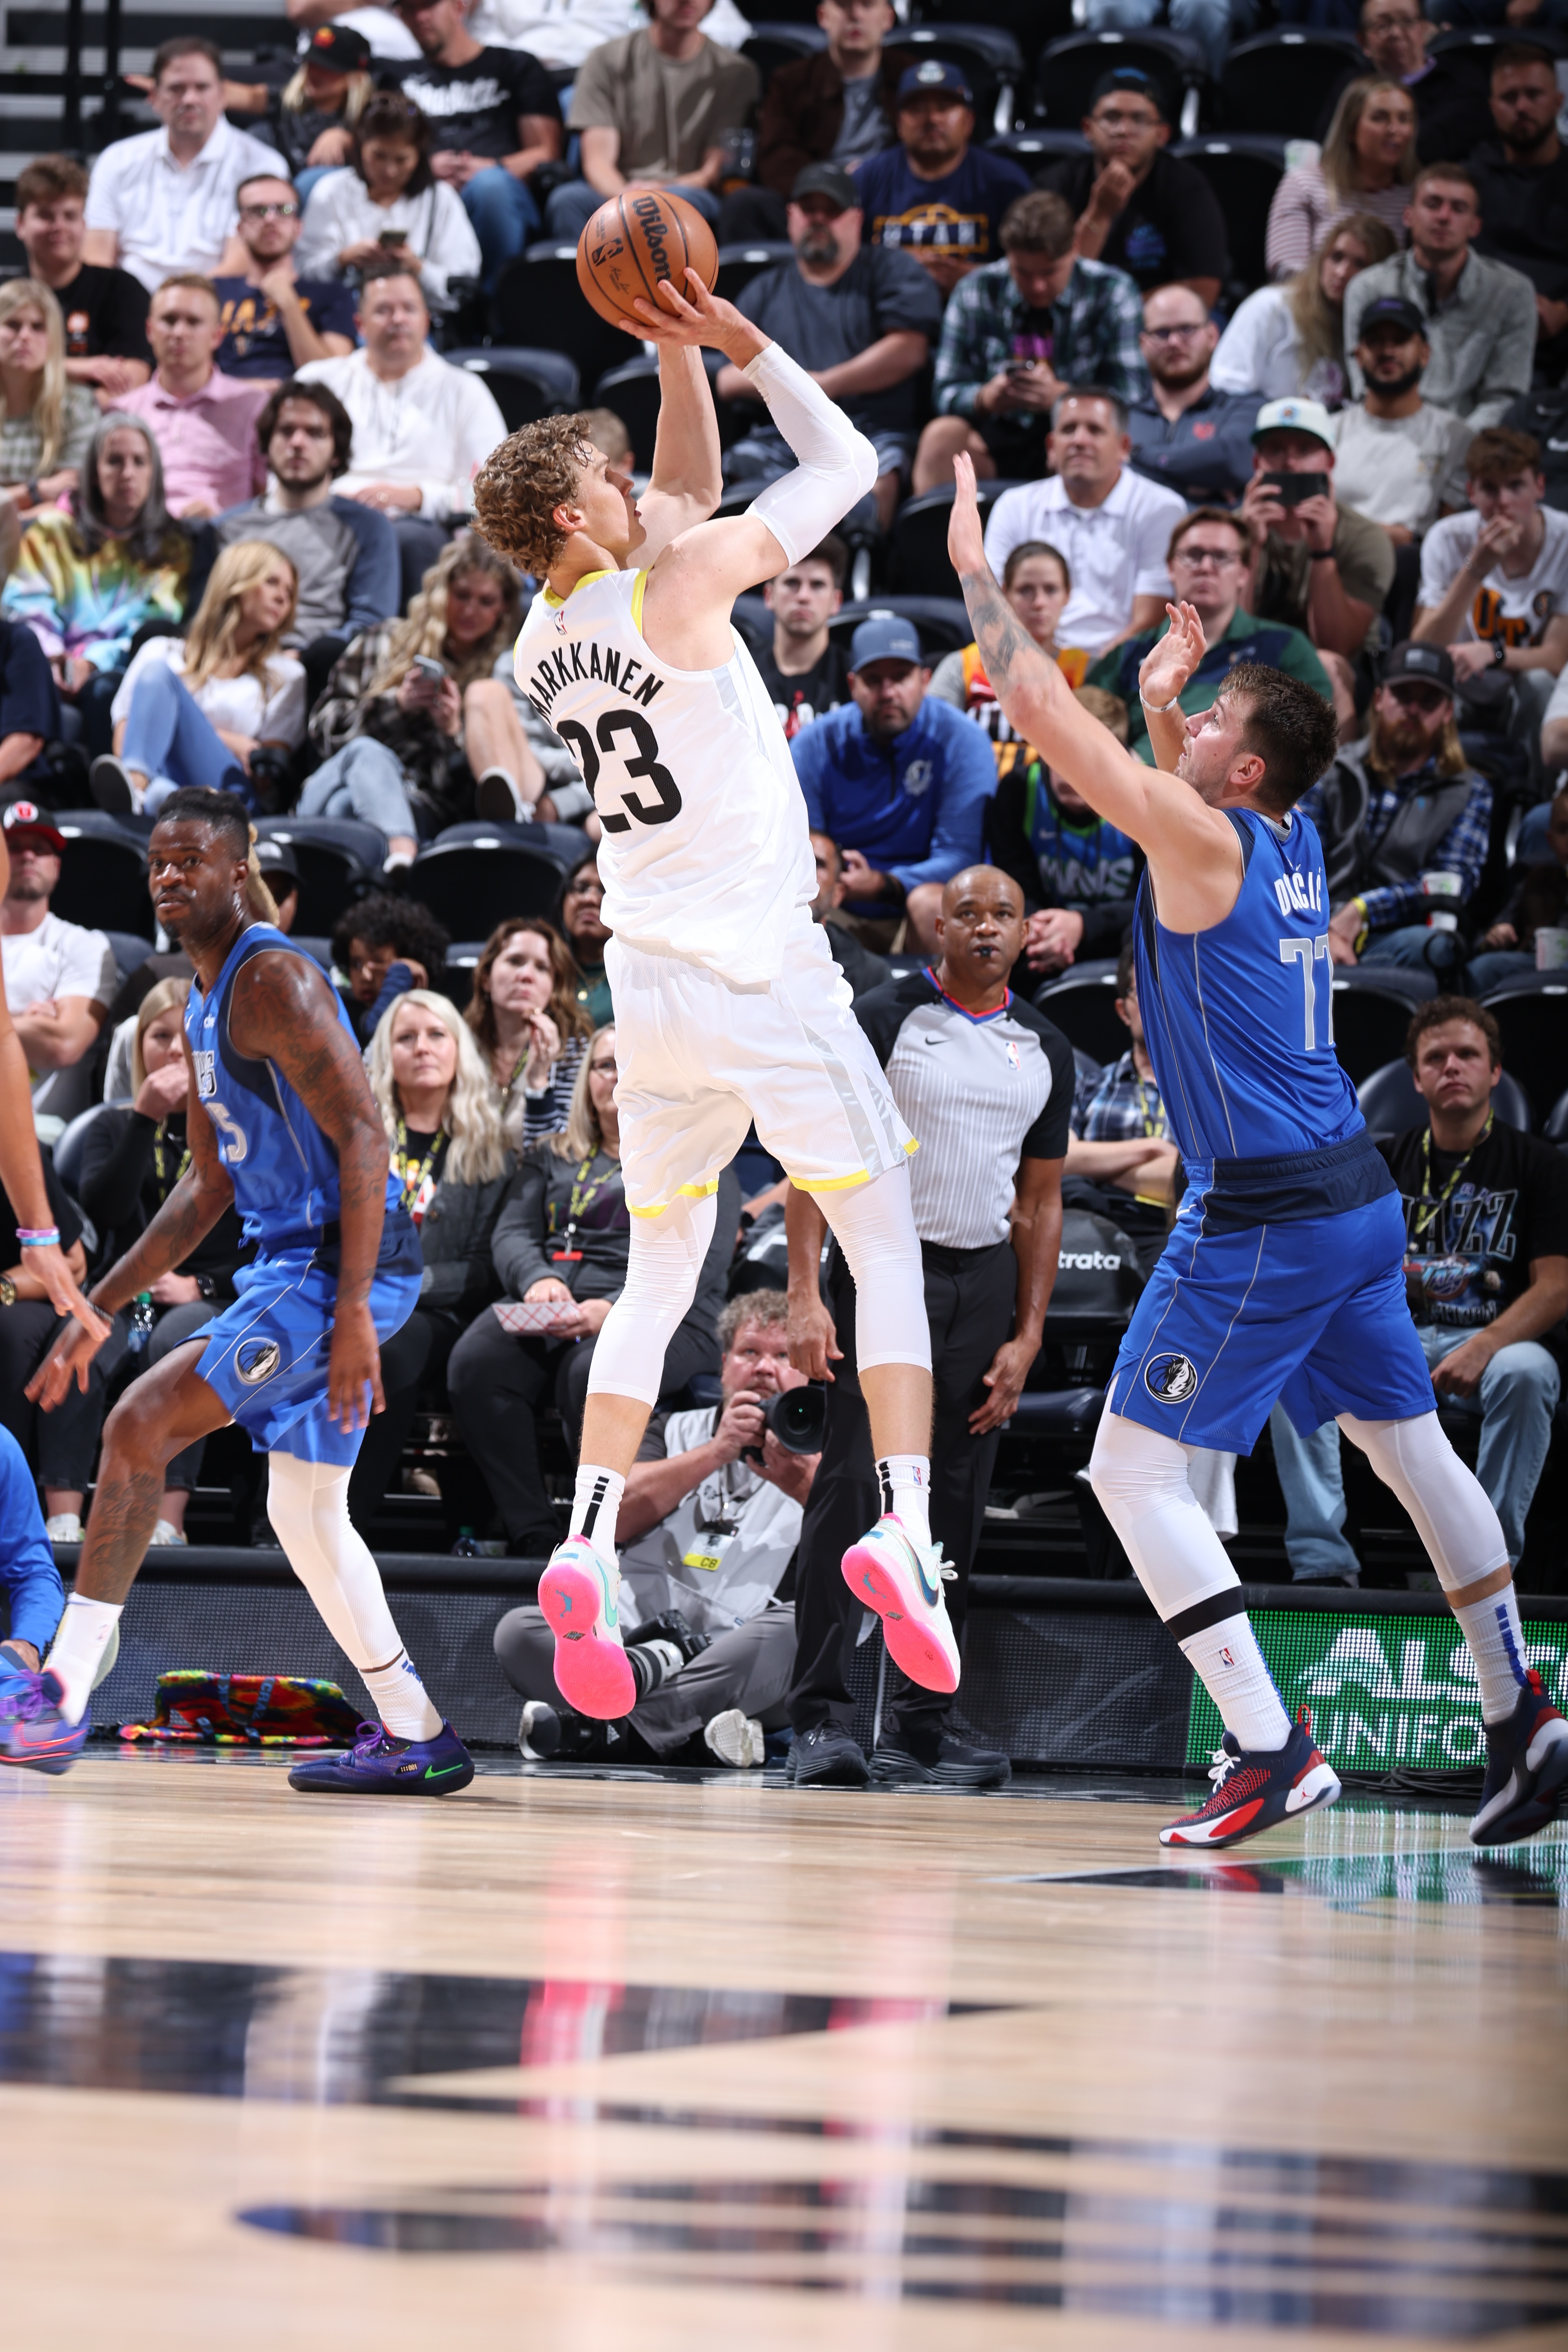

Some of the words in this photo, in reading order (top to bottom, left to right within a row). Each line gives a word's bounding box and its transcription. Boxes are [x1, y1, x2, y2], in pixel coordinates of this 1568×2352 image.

[631, 195, 672, 286] Wilson
[529, 641, 664, 728] MARKKANEN
[556, 709, 682, 833] 23
[1279, 933, 1334, 1051] 77
